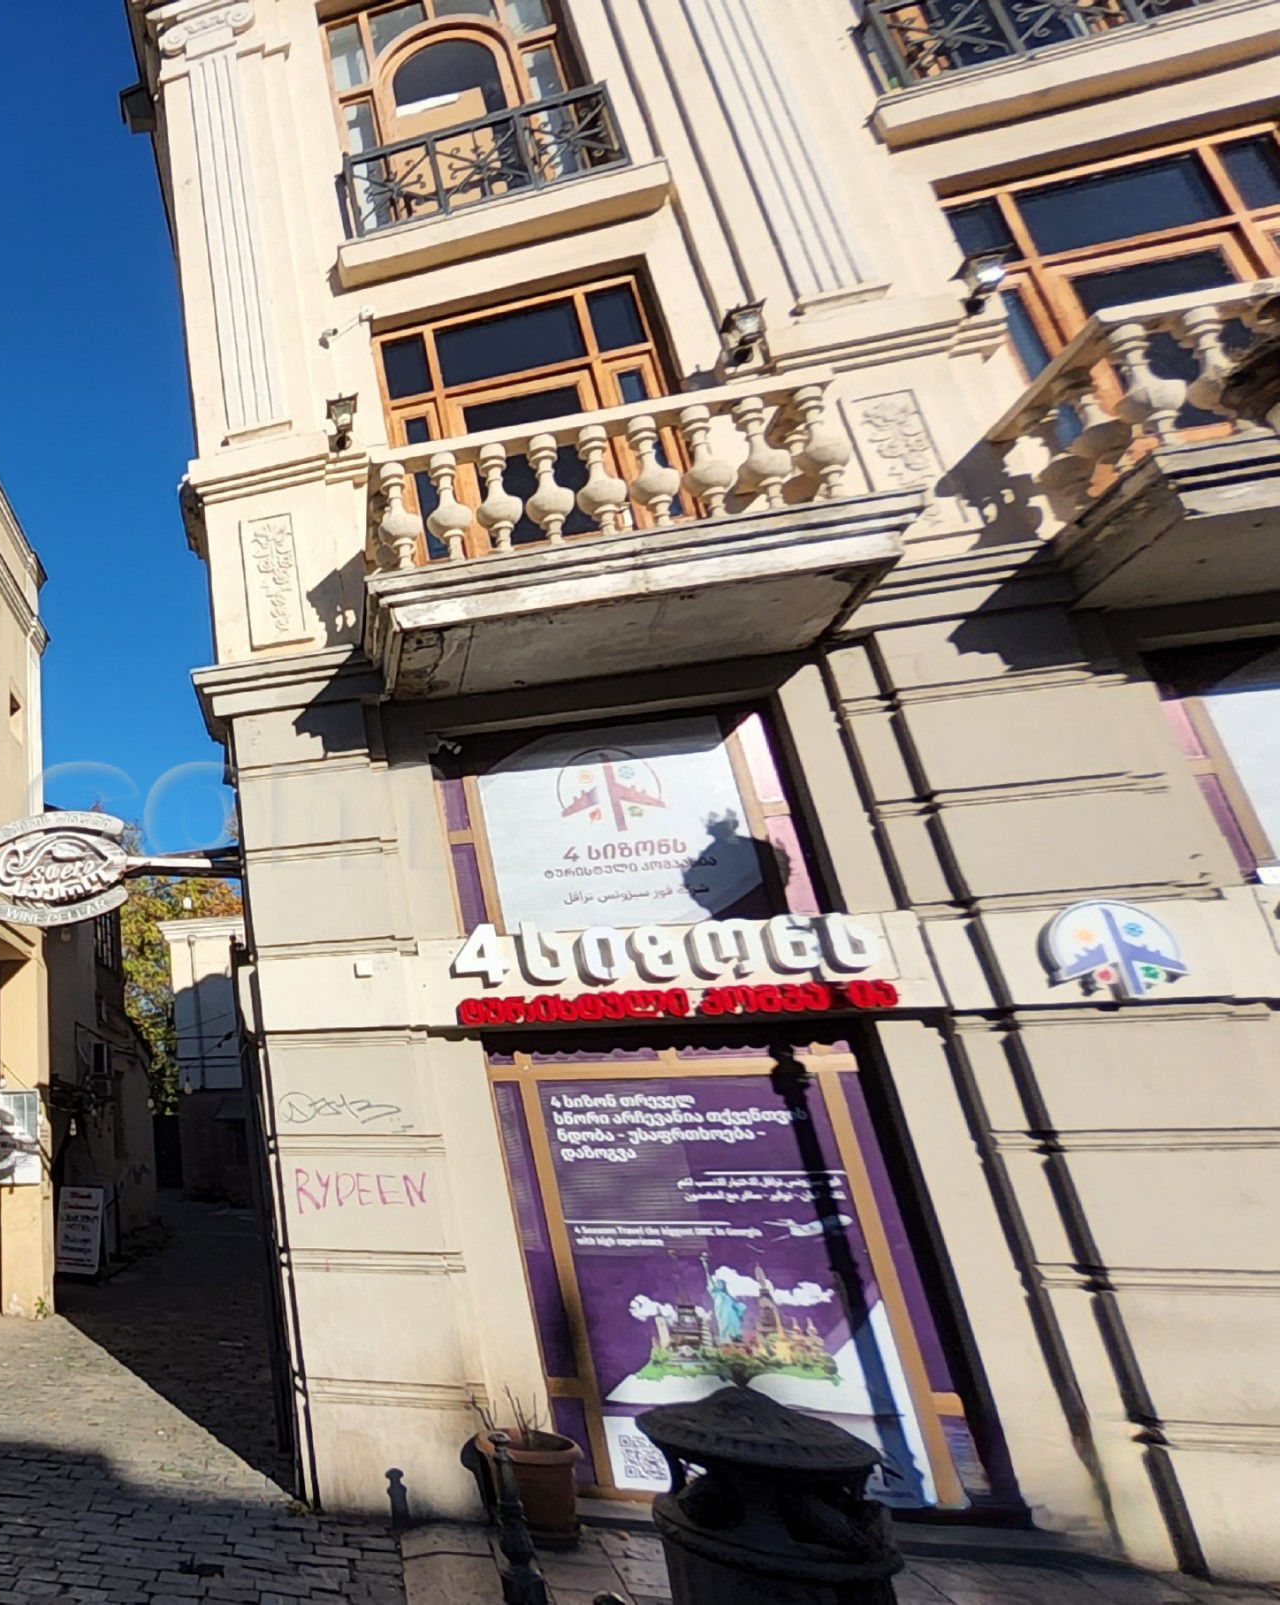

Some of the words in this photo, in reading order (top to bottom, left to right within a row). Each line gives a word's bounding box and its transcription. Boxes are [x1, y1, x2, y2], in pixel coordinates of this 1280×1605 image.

[563, 846, 580, 862] 4
[588, 838, 687, 861] სიზონს
[47, 899, 107, 923] CELLAR
[550, 1095, 562, 1109] 4
[295, 1168, 427, 1214] RYDEEN
